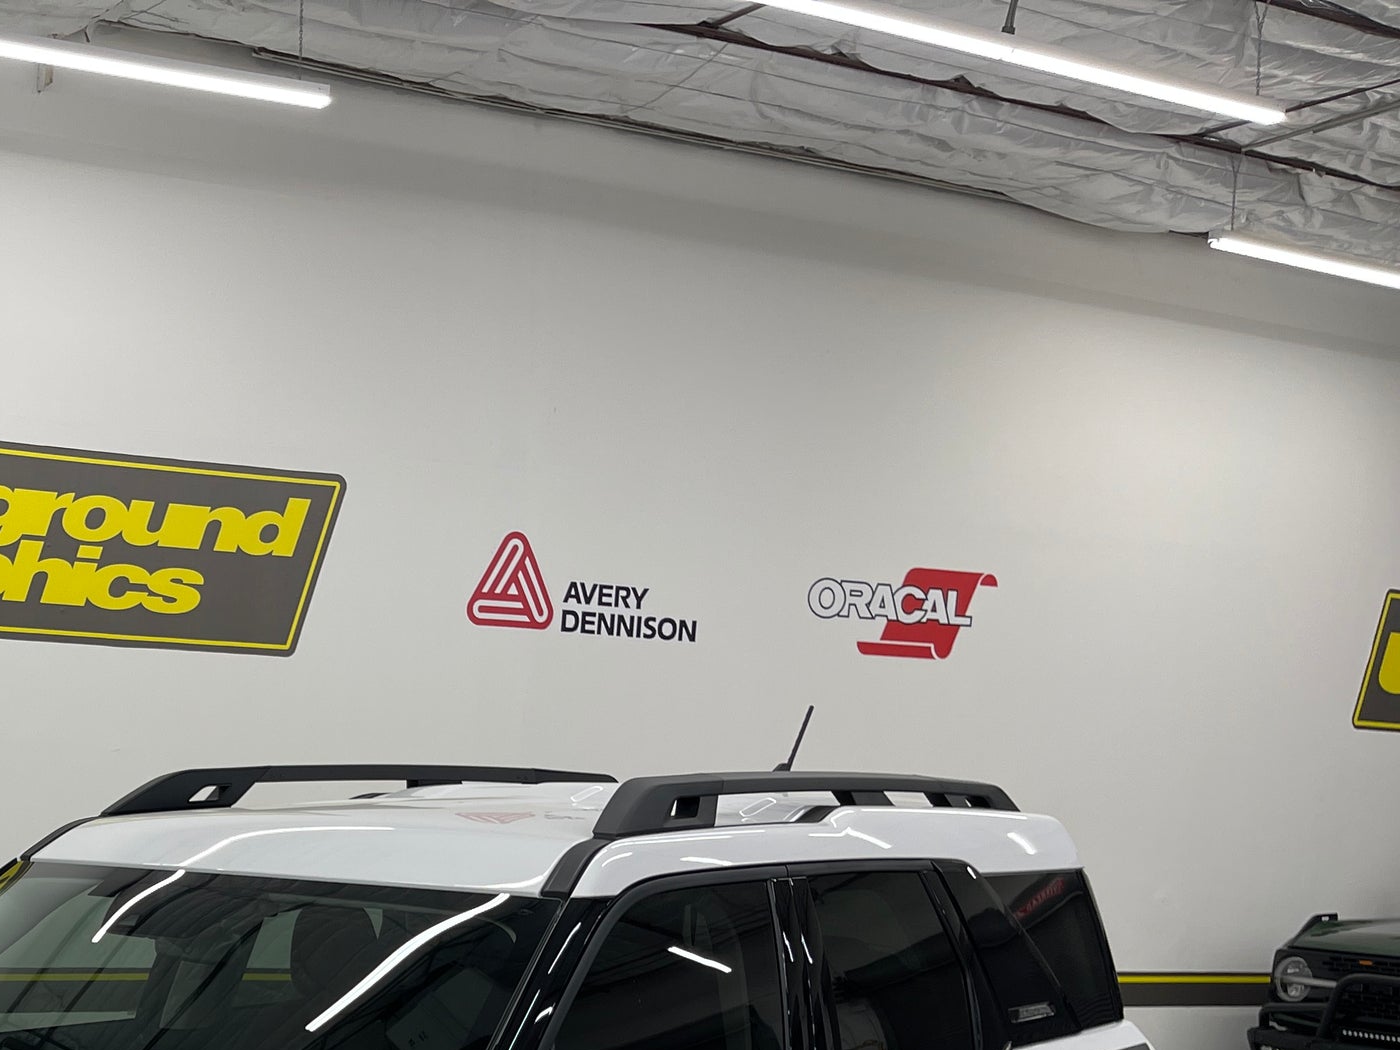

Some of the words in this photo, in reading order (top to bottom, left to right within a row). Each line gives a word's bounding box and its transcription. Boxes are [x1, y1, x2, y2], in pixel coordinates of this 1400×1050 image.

[563, 581, 649, 609] AVERY
[808, 577, 972, 627] ORACAL
[561, 609, 697, 642] DENNISON
